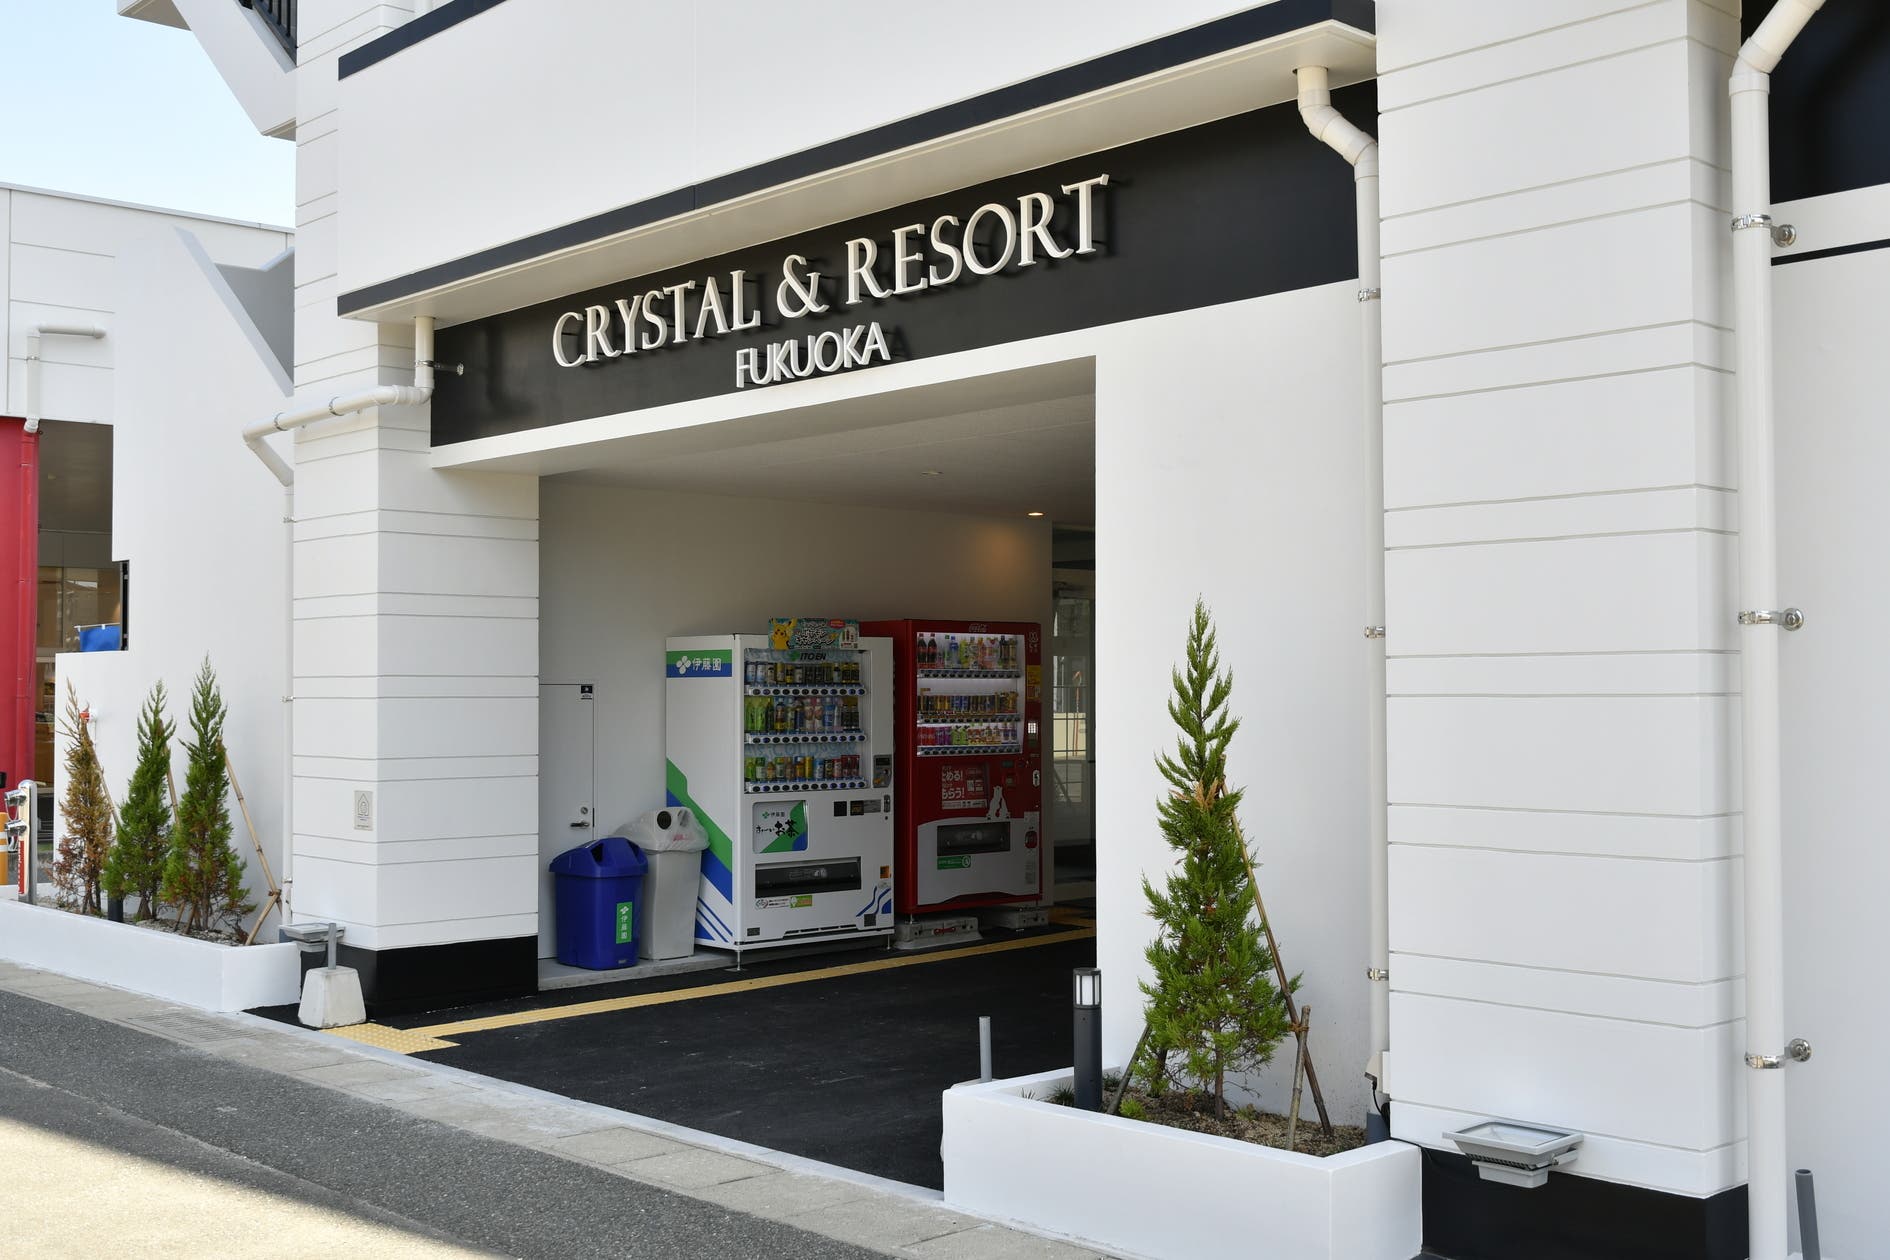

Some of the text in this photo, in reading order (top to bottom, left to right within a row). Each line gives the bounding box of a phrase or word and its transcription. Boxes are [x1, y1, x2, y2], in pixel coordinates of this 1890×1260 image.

[552, 173, 1110, 368] CRYSTAL & RESORT
[735, 321, 892, 389] FUKUOKA
[691, 656, 722, 672] 伊藤園
